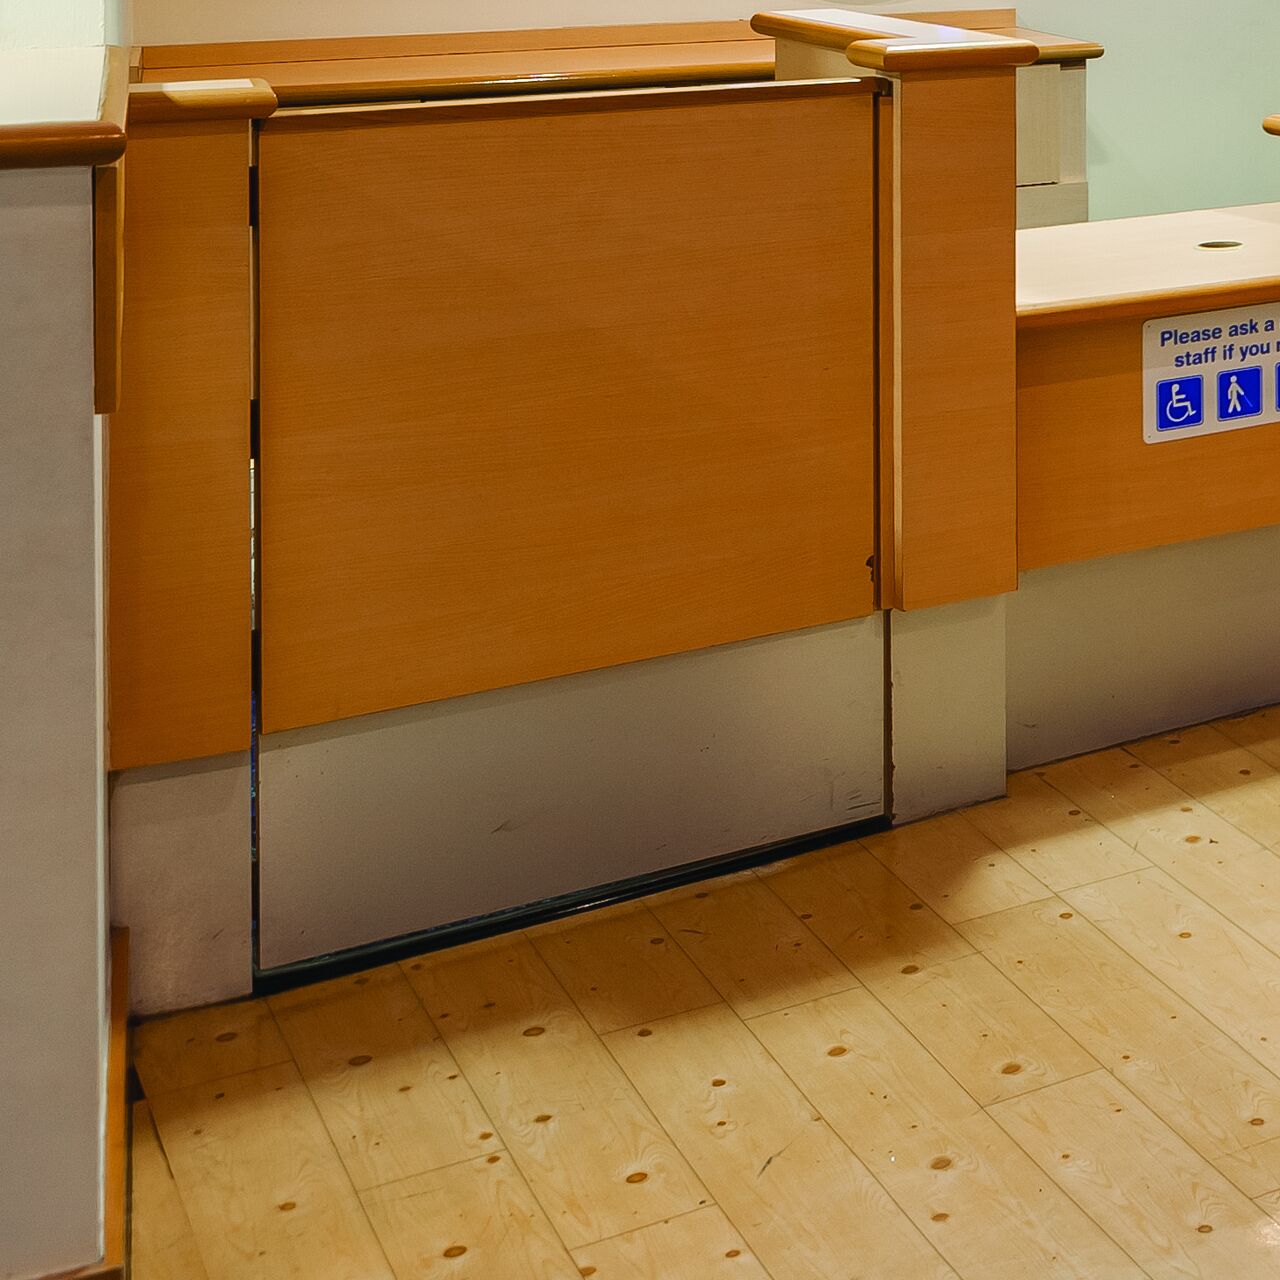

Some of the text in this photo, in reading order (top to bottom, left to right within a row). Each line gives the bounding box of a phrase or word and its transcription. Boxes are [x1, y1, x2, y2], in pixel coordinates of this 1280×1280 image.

[1160, 324, 1223, 347] Please
[1228, 319, 1259, 337] ask
[1264, 318, 1275, 332] a
[1174, 345, 1217, 368] staff
[1222, 343, 1235, 361] if
[1239, 340, 1271, 362] you
